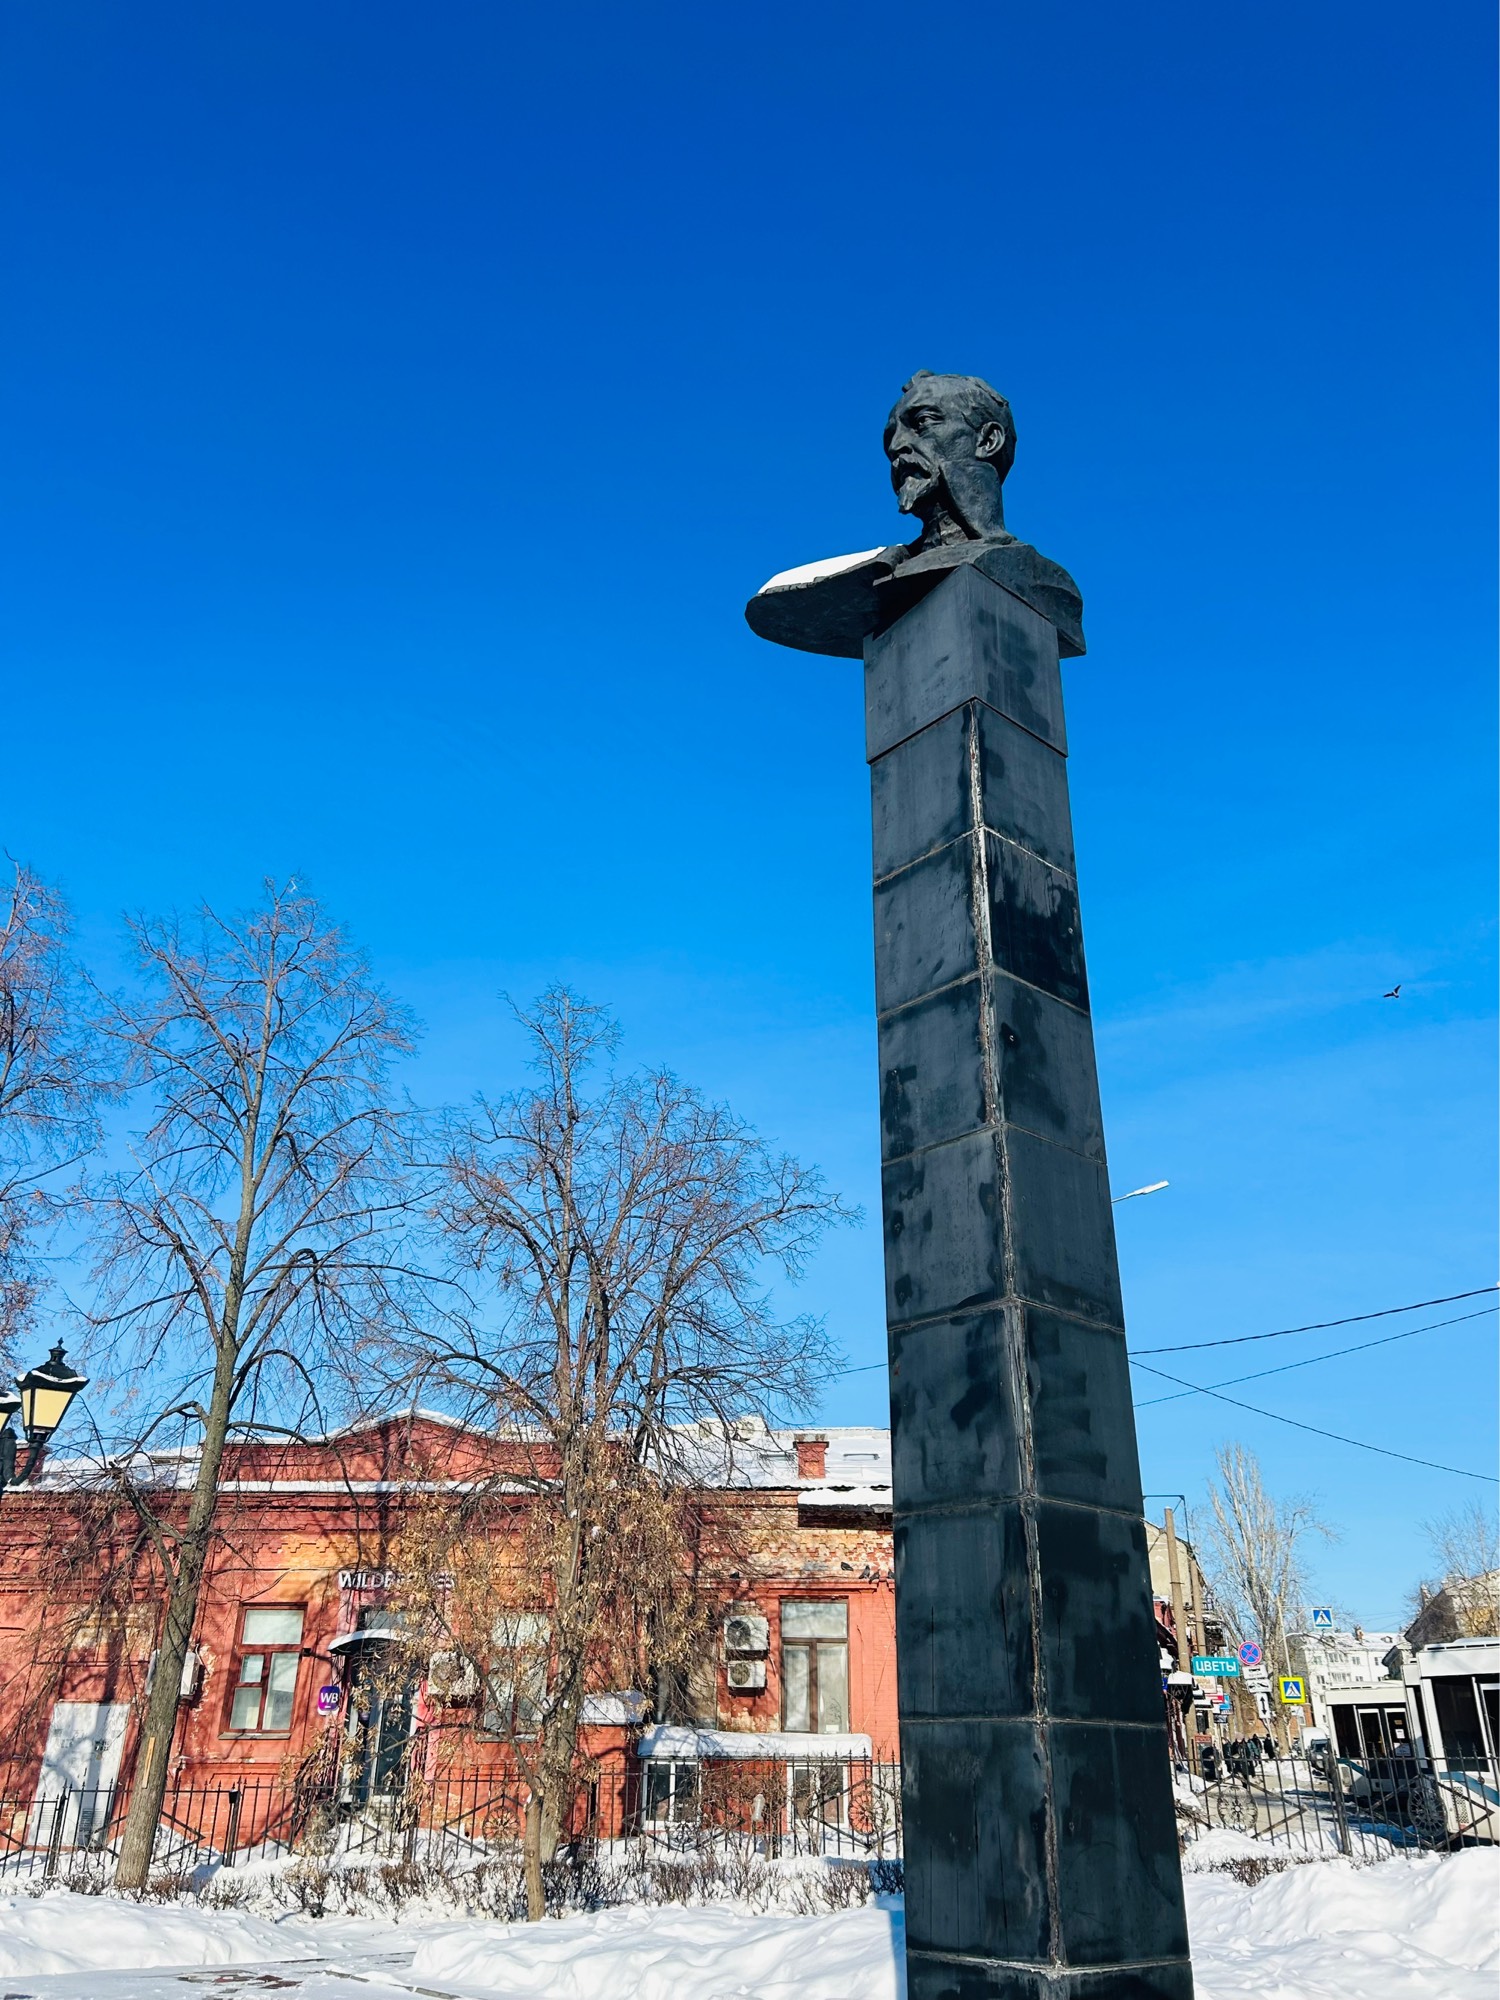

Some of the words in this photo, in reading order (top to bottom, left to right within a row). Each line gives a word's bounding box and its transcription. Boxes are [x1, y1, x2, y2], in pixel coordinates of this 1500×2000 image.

[338, 1569, 455, 1590] WILDBES
[1195, 1660, 1237, 1673] ЦВЕТЫ
[320, 1692, 339, 1703] WB
